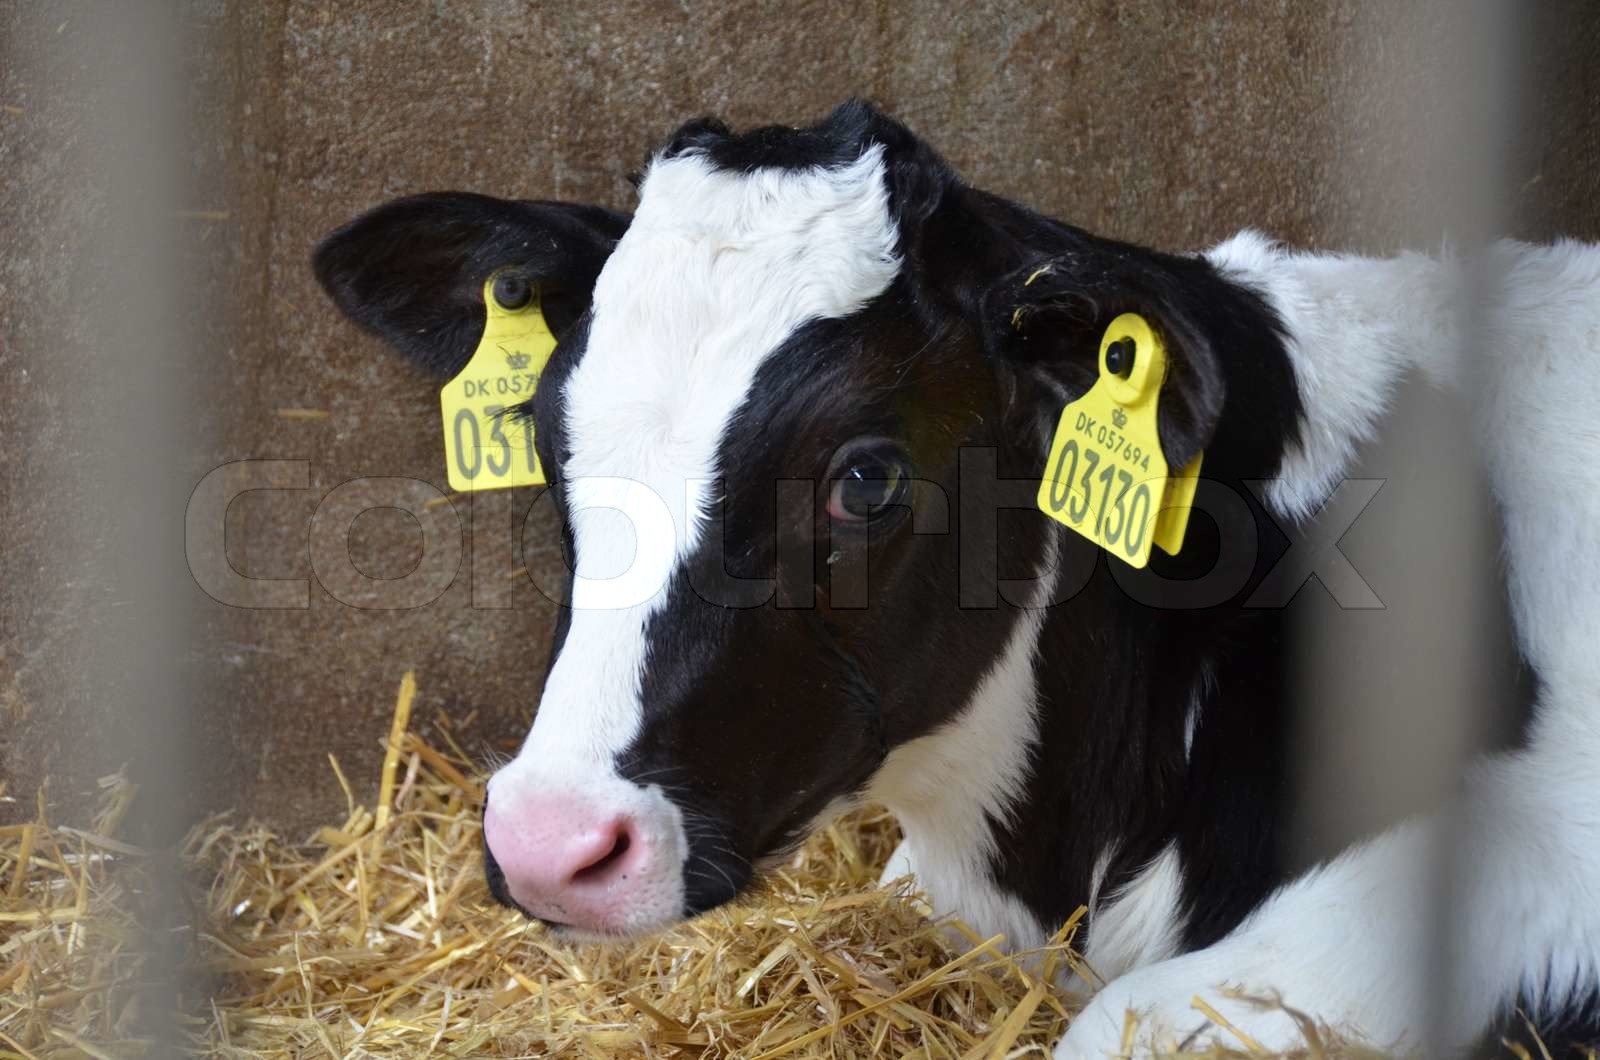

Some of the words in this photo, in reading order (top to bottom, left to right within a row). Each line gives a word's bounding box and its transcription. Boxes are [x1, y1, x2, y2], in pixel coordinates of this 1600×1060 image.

[463, 379, 490, 398] DK
[1075, 411, 1097, 440] DK
[1097, 426, 1150, 473] 057694
[1050, 439, 1150, 558] 03130
